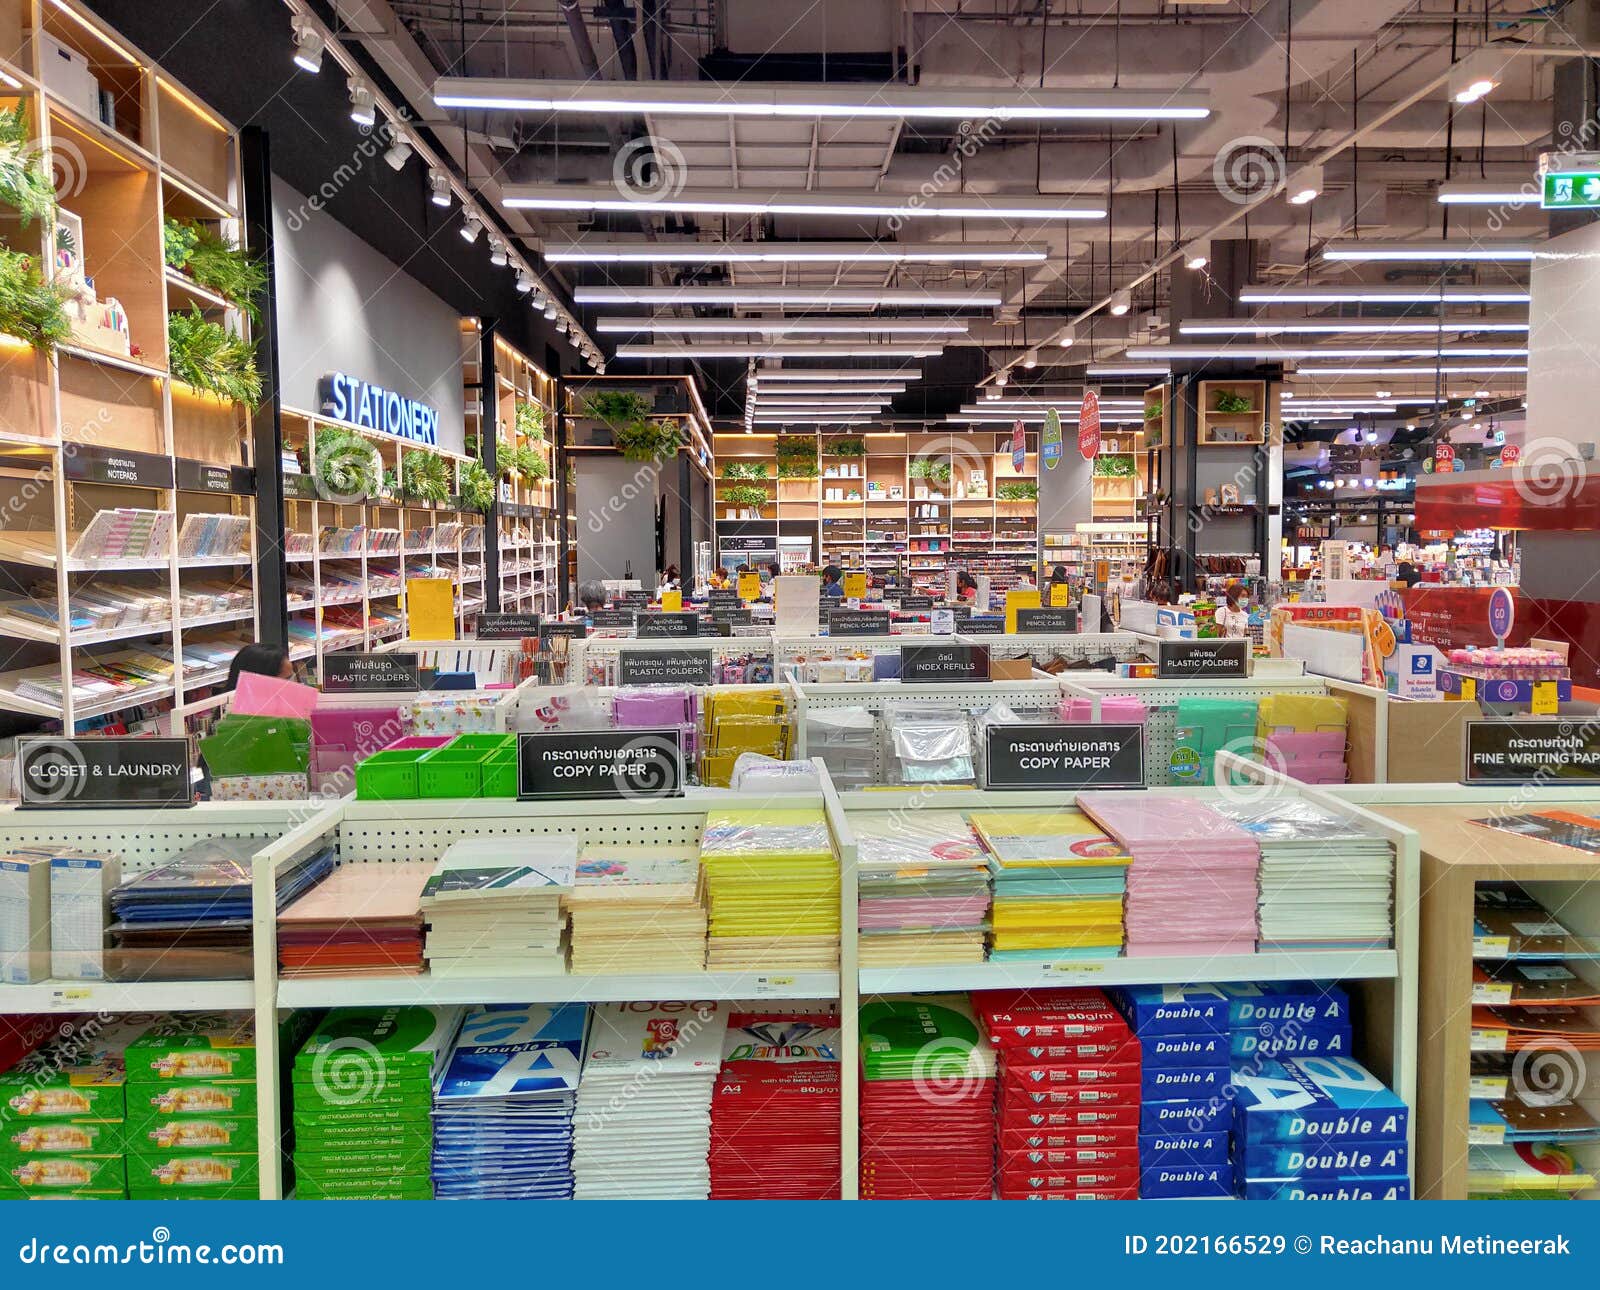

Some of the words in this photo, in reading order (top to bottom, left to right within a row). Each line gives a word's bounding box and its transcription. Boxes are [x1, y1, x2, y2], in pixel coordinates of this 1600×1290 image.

[332, 372, 440, 445] STATIONERY
[107, 470, 138, 481] NOTEPADS
[207, 480, 229, 489] NOTEPADS
[916, 663, 941, 671] INDEX
[943, 662, 975, 670] REFILLS
[1202, 659, 1239, 667] FOLDERS
[332, 674, 368, 682] PLASTIC
[370, 673, 410, 682] FOLDERS
[630, 668, 664, 676] PLASTIC
[666, 667, 704, 675] FOLDERS
[1009, 738, 1121, 753] กระดาษถ่ายเอกสาร
[542, 745, 658, 761] กระดาษถ่ายเอกสาร
[1473, 753, 1505, 764] FINE
[1508, 753, 1569, 764] WRITING
[1020, 757, 1058, 770] COPY
[1064, 756, 1111, 769] PAPER
[28, 764, 88, 778] CLOSET
[93, 764, 103, 777] &
[108, 763, 183, 777] LAUNDRY
[553, 765, 595, 778] COPY
[600, 763, 647, 777] PAPER
[1155, 1007, 1201, 1019] Double
[1205, 1006, 1215, 1018] A
[1239, 1003, 1316, 1020] Double
[1324, 1001, 1339, 1018] A
[992, 1014, 1012, 1022] F4
[474, 1043, 538, 1055] Double
[1156, 1042, 1201, 1053] Double
[1206, 1041, 1215, 1052] A
[1242, 1036, 1319, 1052] Double
[1326, 1034, 1342, 1050] A
[727, 1044, 837, 1062] Diamond
[1156, 1073, 1201, 1084] Double
[1206, 1072, 1215, 1083] A
[721, 1085, 742, 1093] A4
[1159, 1108, 1204, 1119] Double
[1207, 1107, 1217, 1117] A
[1288, 1118, 1373, 1136] Double
[1381, 1115, 1398, 1134] A
[1154, 1139, 1199, 1151] Double
[1204, 1138, 1213, 1149] A
[1288, 1152, 1372, 1170] Double
[1380, 1150, 1397, 1168] A
[1160, 1171, 1204, 1182] Double
[1208, 1170, 1217, 1181] A
[1289, 1188, 1373, 1200] Double
[1381, 1186, 1398, 1200] A
